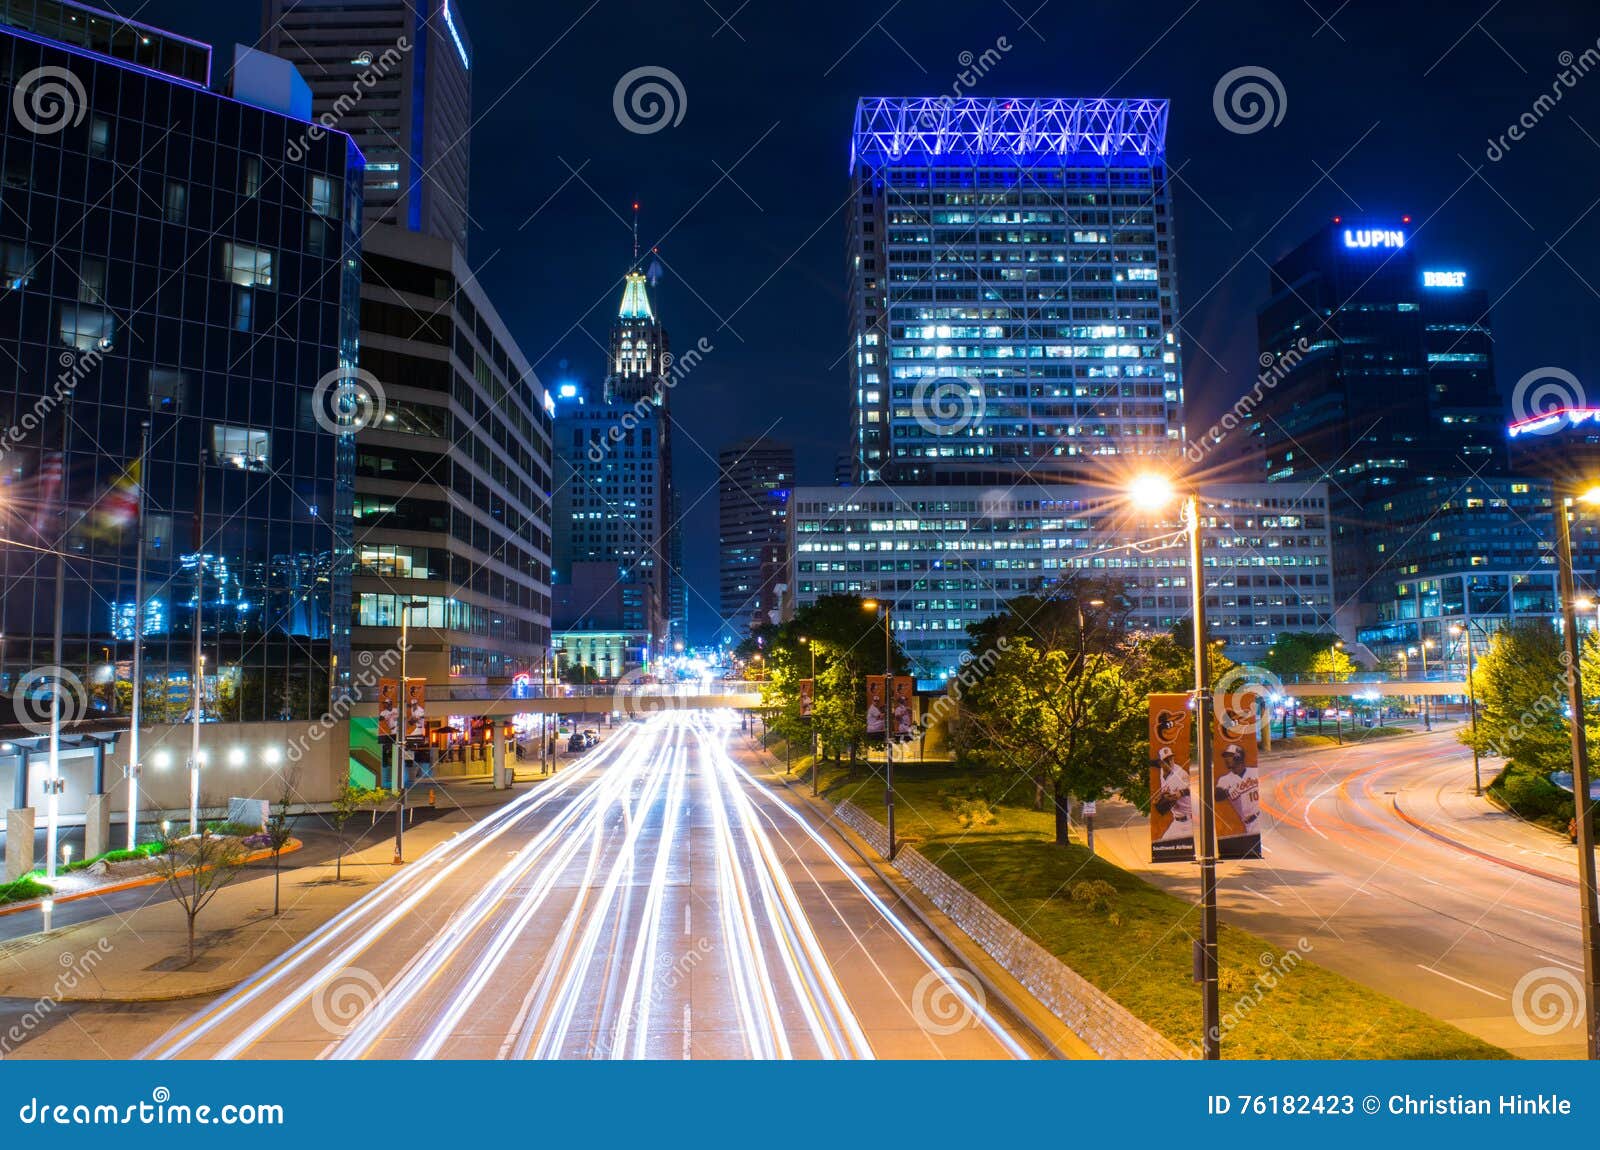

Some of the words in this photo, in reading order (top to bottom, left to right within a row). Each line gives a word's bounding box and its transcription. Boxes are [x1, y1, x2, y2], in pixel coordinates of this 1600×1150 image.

[1344, 230, 1404, 248] LUPIN
[1423, 271, 1466, 287] BB&T
[1249, 790, 1259, 802] 10
